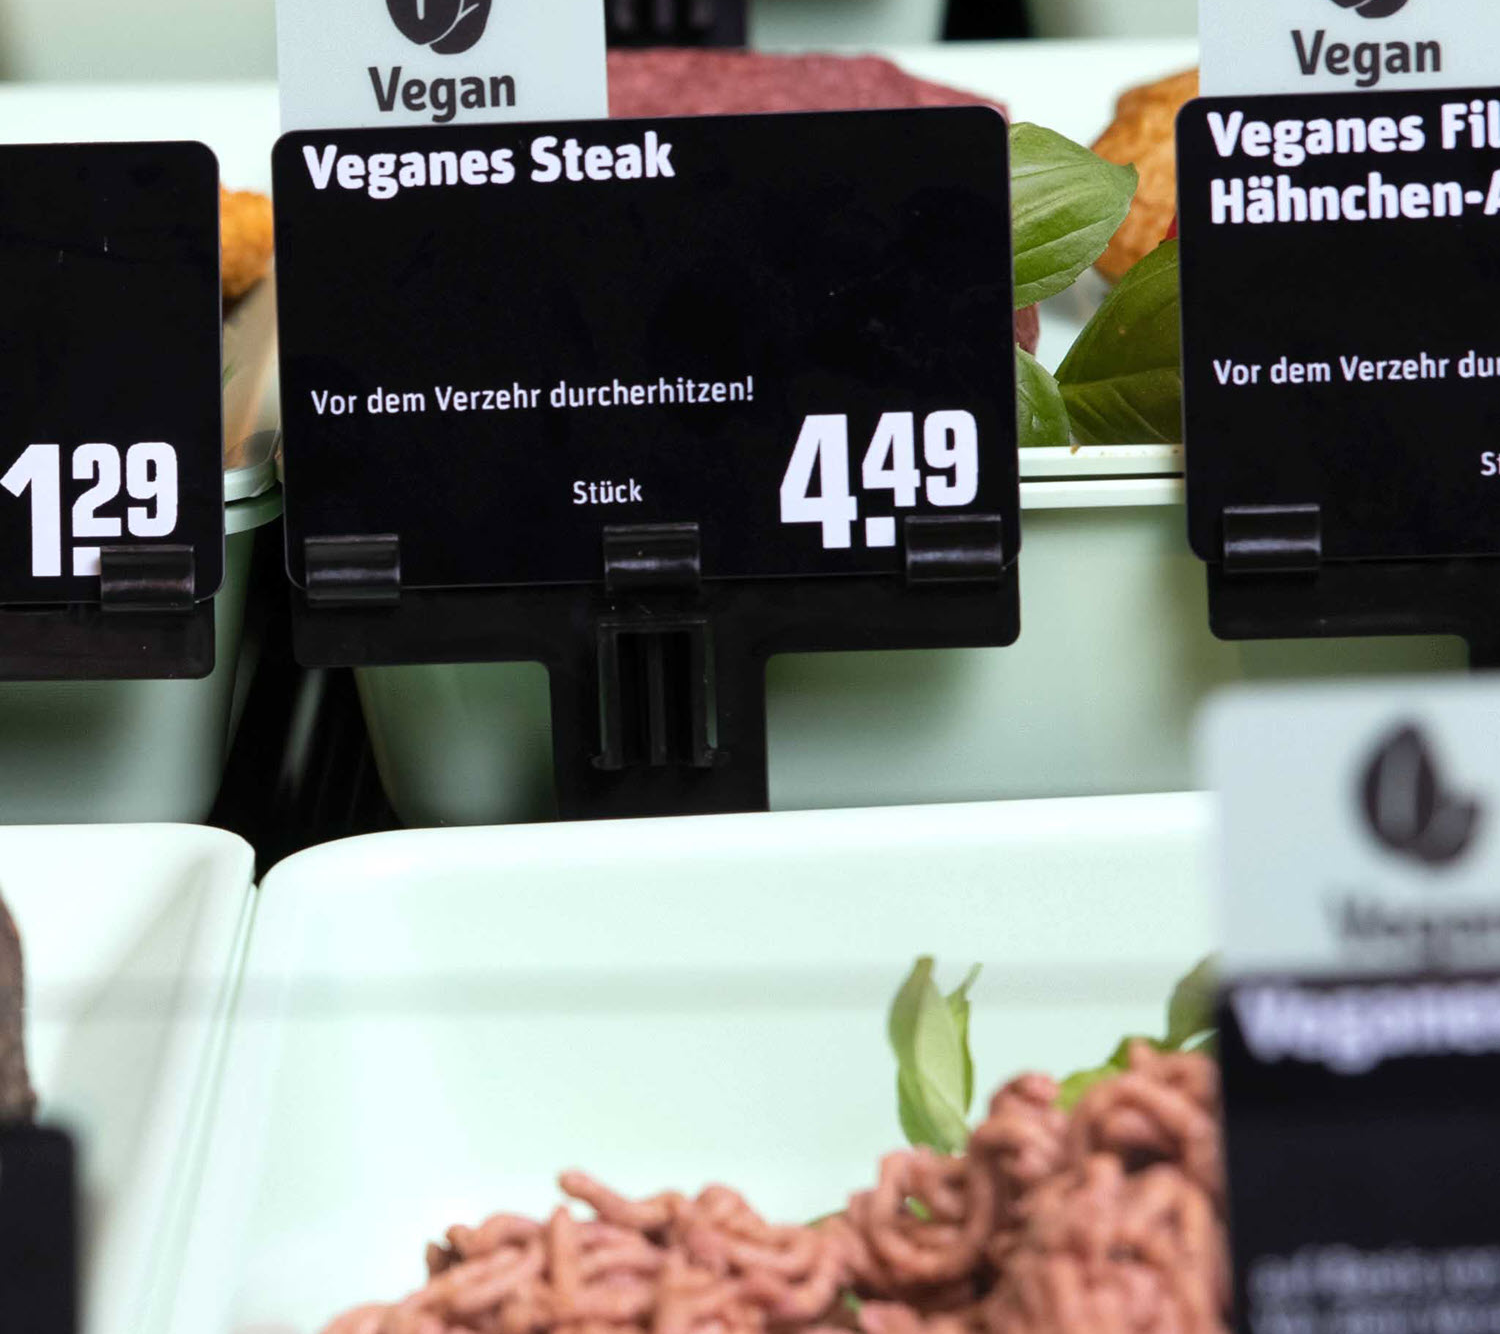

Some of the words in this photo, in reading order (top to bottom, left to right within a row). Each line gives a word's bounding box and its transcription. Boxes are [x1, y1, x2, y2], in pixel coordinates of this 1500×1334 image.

[1290, 29, 1445, 90] Vegan
[367, 65, 519, 124] Vegan
[302, 144, 516, 200] Veganes
[530, 130, 676, 183] Steak
[1206, 110, 1426, 167] Veganes
[310, 390, 358, 415] Vor
[367, 386, 426, 414] dem
[434, 383, 542, 412] Verzehr
[550, 375, 754, 408] durcherhitzen!
[1212, 359, 1262, 386] Vor
[1270, 356, 1331, 384] dem
[1339, 351, 1450, 382] Verzehr
[573, 478, 643, 505] Stück
[779, 409, 979, 549] 4.49
[0, 441, 179, 577] 1.29
